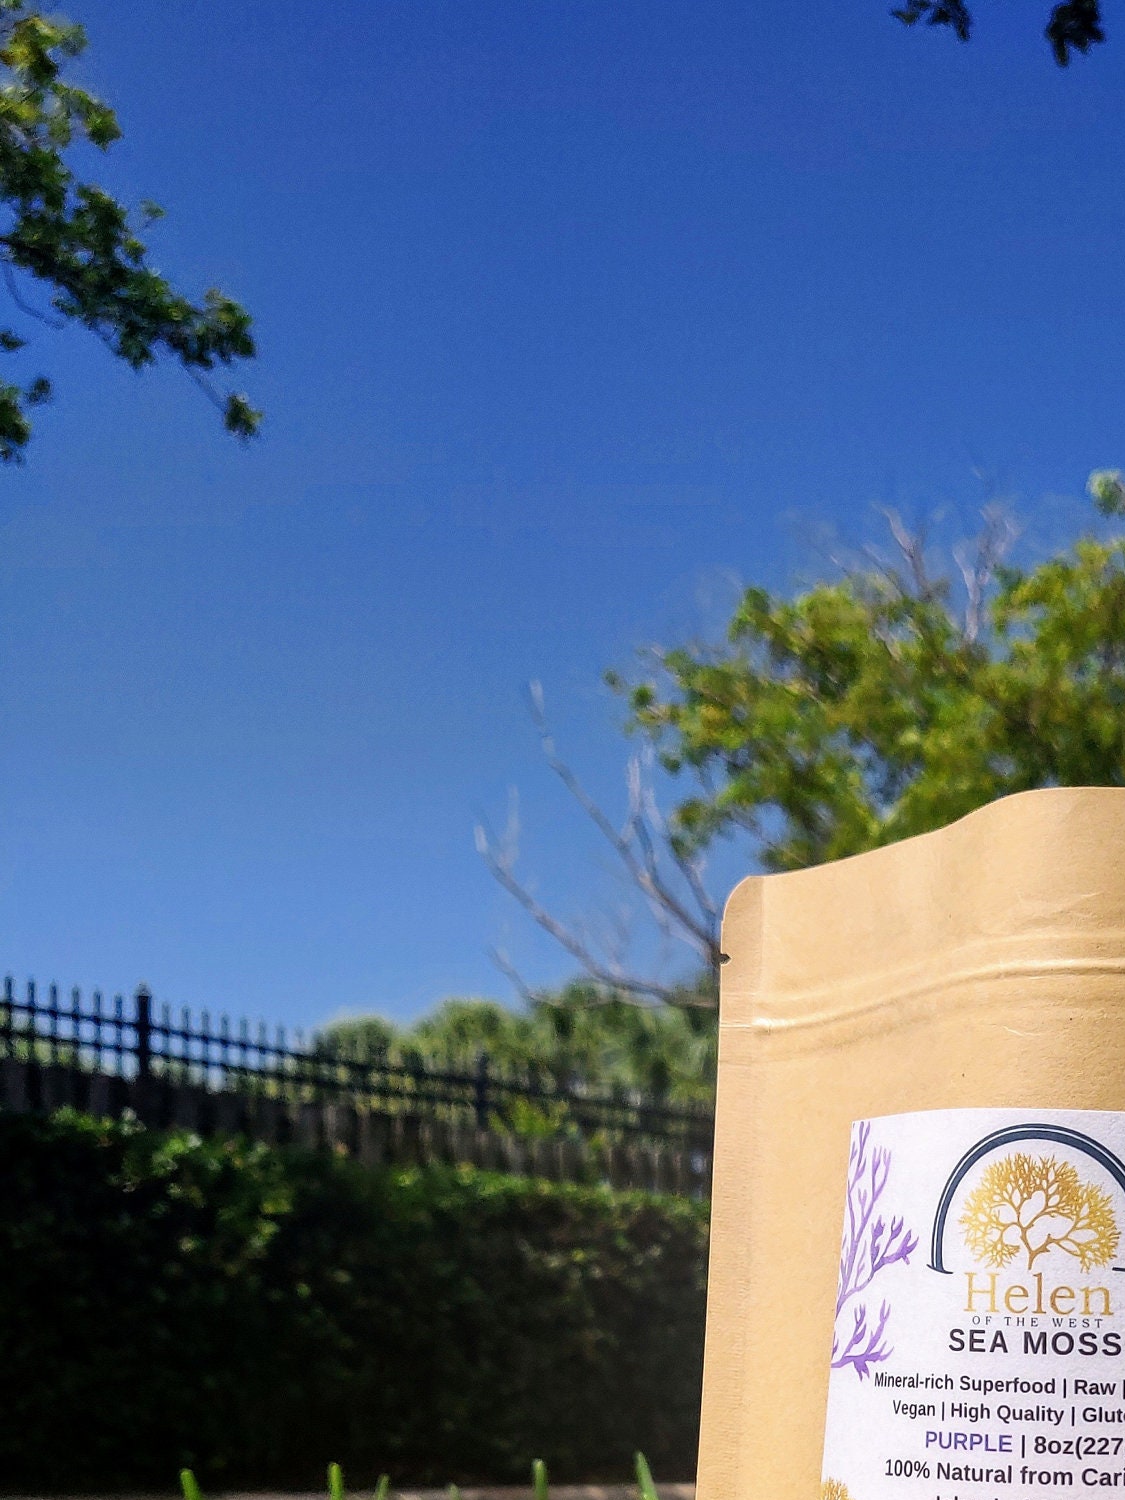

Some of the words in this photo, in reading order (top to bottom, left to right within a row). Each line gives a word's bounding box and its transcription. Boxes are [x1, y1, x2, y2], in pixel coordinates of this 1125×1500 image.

[963, 1271, 1114, 1316] Helen
[971, 1316, 993, 1327] OF
[1003, 1316, 1040, 1328] THE
[1051, 1317, 1104, 1329] WEST
[948, 1328, 1009, 1354] SEA
[1023, 1331, 1122, 1357] MOSS
[874, 1371, 954, 1390] Mineral-rich
[959, 1375, 1056, 1396] Superfood
[1074, 1379, 1117, 1396] Raw
[892, 1399, 936, 1420] Vegan
[950, 1402, 991, 1423] High
[996, 1404, 1065, 1426] Quality
[925, 1430, 1013, 1453] PURPLE
[884, 1458, 931, 1479] 100%
[936, 1462, 1013, 1484] Natural
[1019, 1465, 1073, 1486] from
